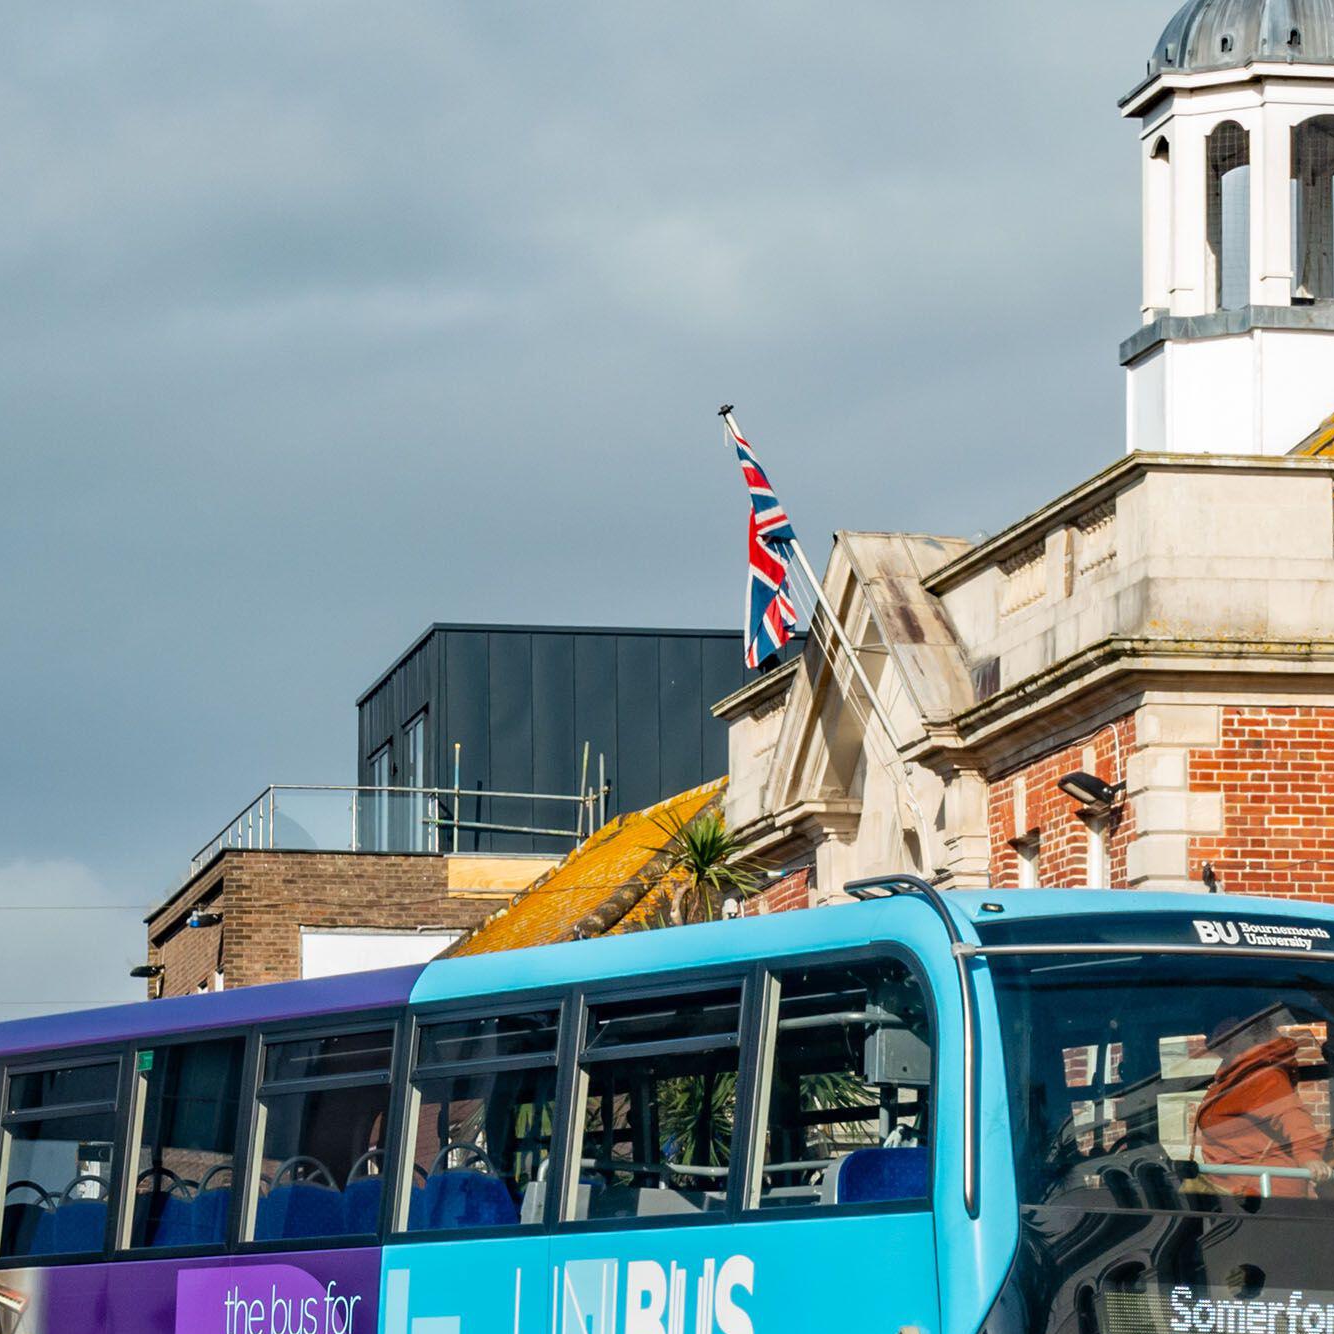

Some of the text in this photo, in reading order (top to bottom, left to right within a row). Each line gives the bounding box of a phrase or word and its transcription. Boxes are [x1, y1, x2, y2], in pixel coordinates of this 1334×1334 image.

[1192, 919, 1240, 945] BU
[1238, 921, 1331, 939] Bournemouth
[1244, 932, 1313, 950] University
